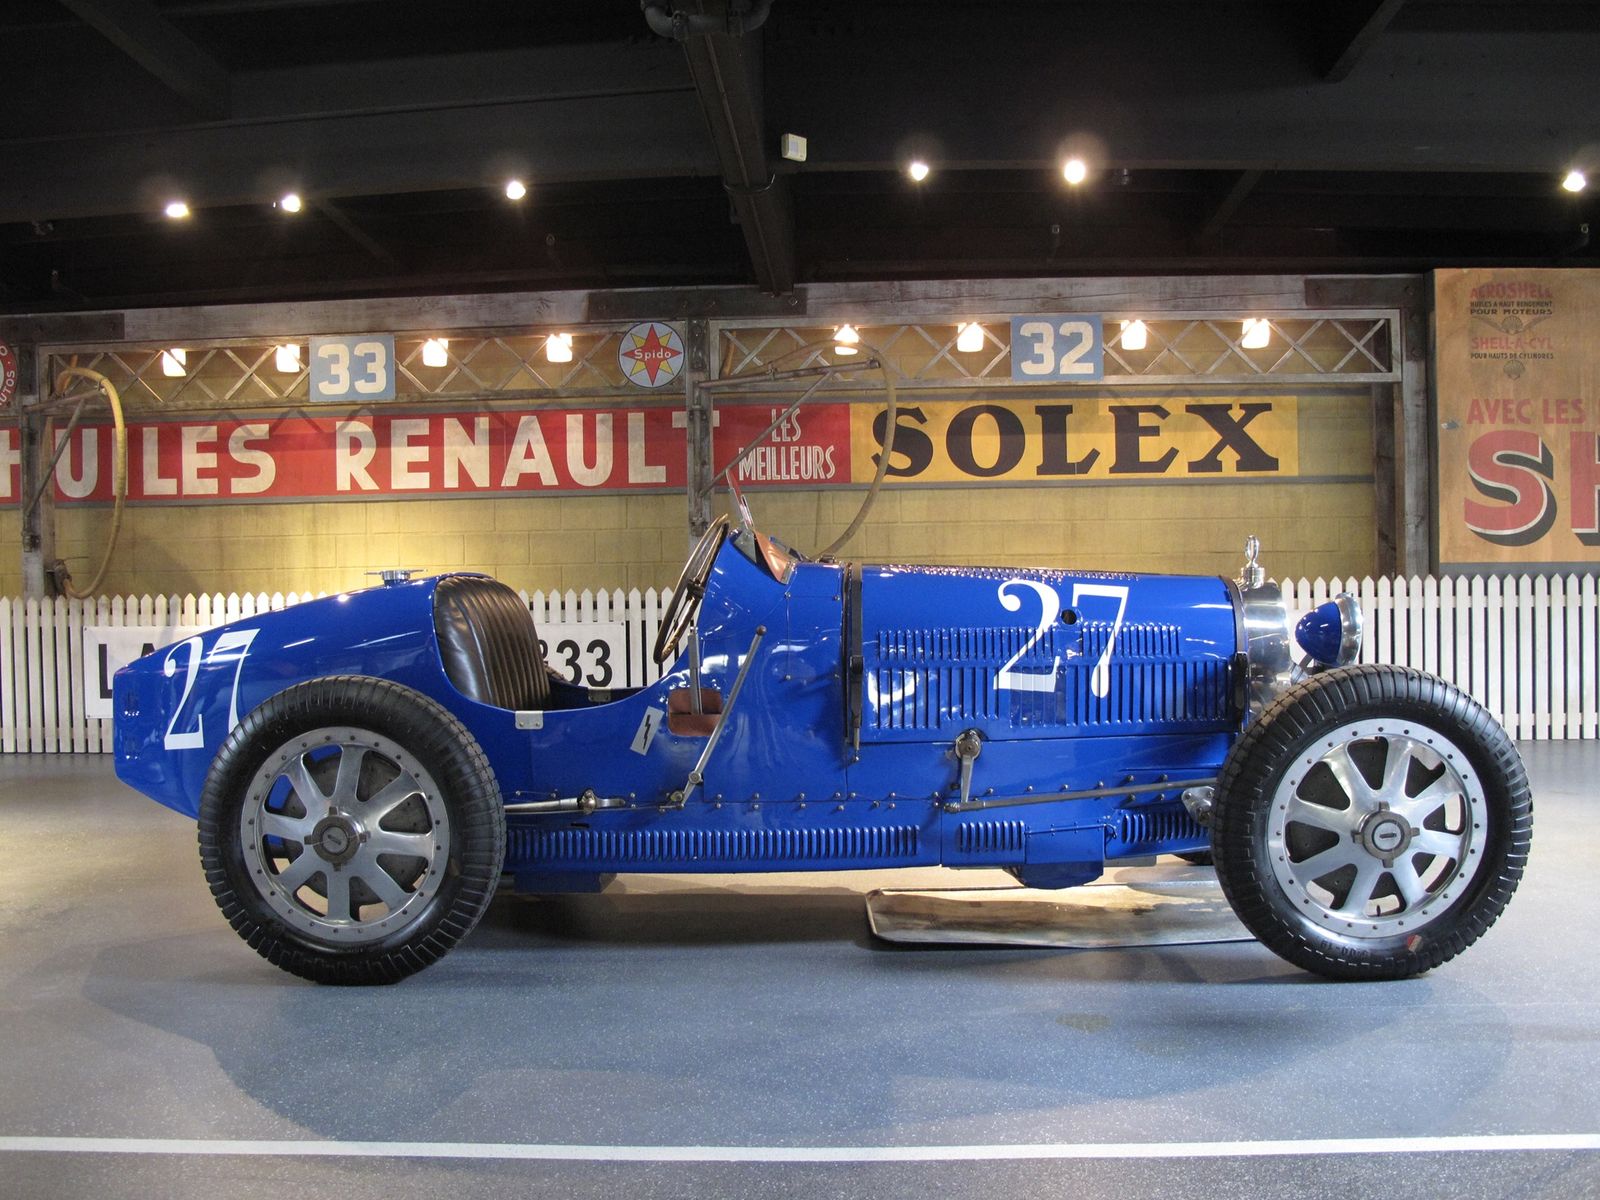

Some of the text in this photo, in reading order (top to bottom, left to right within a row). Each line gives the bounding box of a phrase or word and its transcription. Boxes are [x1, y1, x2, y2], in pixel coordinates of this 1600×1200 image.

[317, 342, 387, 395] 33
[634, 348, 672, 361] Spido
[1019, 321, 1095, 375] 32
[0, 370, 16, 405] UTOS
[1466, 398, 1587, 424] AVEC LES
[335, 410, 720, 491] RENAUL
[771, 408, 801, 442] LES
[871, 402, 1279, 478] SOLEX
[738, 445, 836, 481] MEILLEURS
[993, 578, 1129, 699] 27
[163, 628, 261, 750] 27
